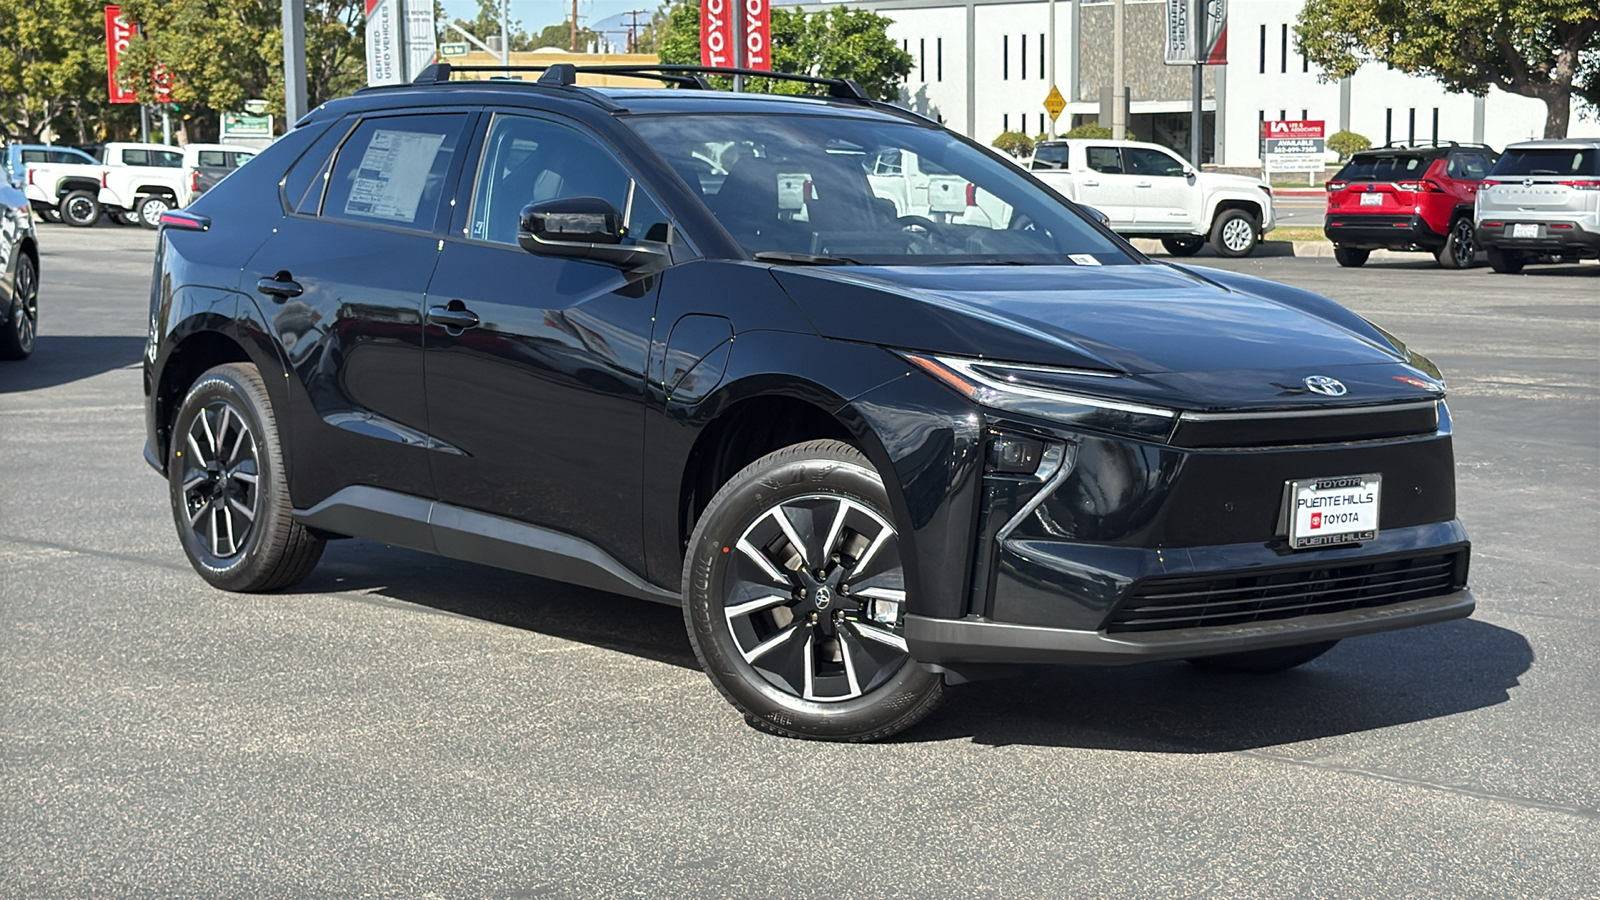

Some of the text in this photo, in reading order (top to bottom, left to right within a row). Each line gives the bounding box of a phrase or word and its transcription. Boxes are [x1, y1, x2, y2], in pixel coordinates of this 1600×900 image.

[382, 6, 390, 52] VEHICLES
[113, 15, 133, 98] TOTA
[375, 30, 383, 79] CERTIFIED
[1318, 478, 1360, 488] TOYOTA
[1297, 493, 1373, 509] PUENTE HILLS
[1324, 512, 1359, 525] TOYOTA
[1297, 532, 1374, 546] PUENTE HILLS
